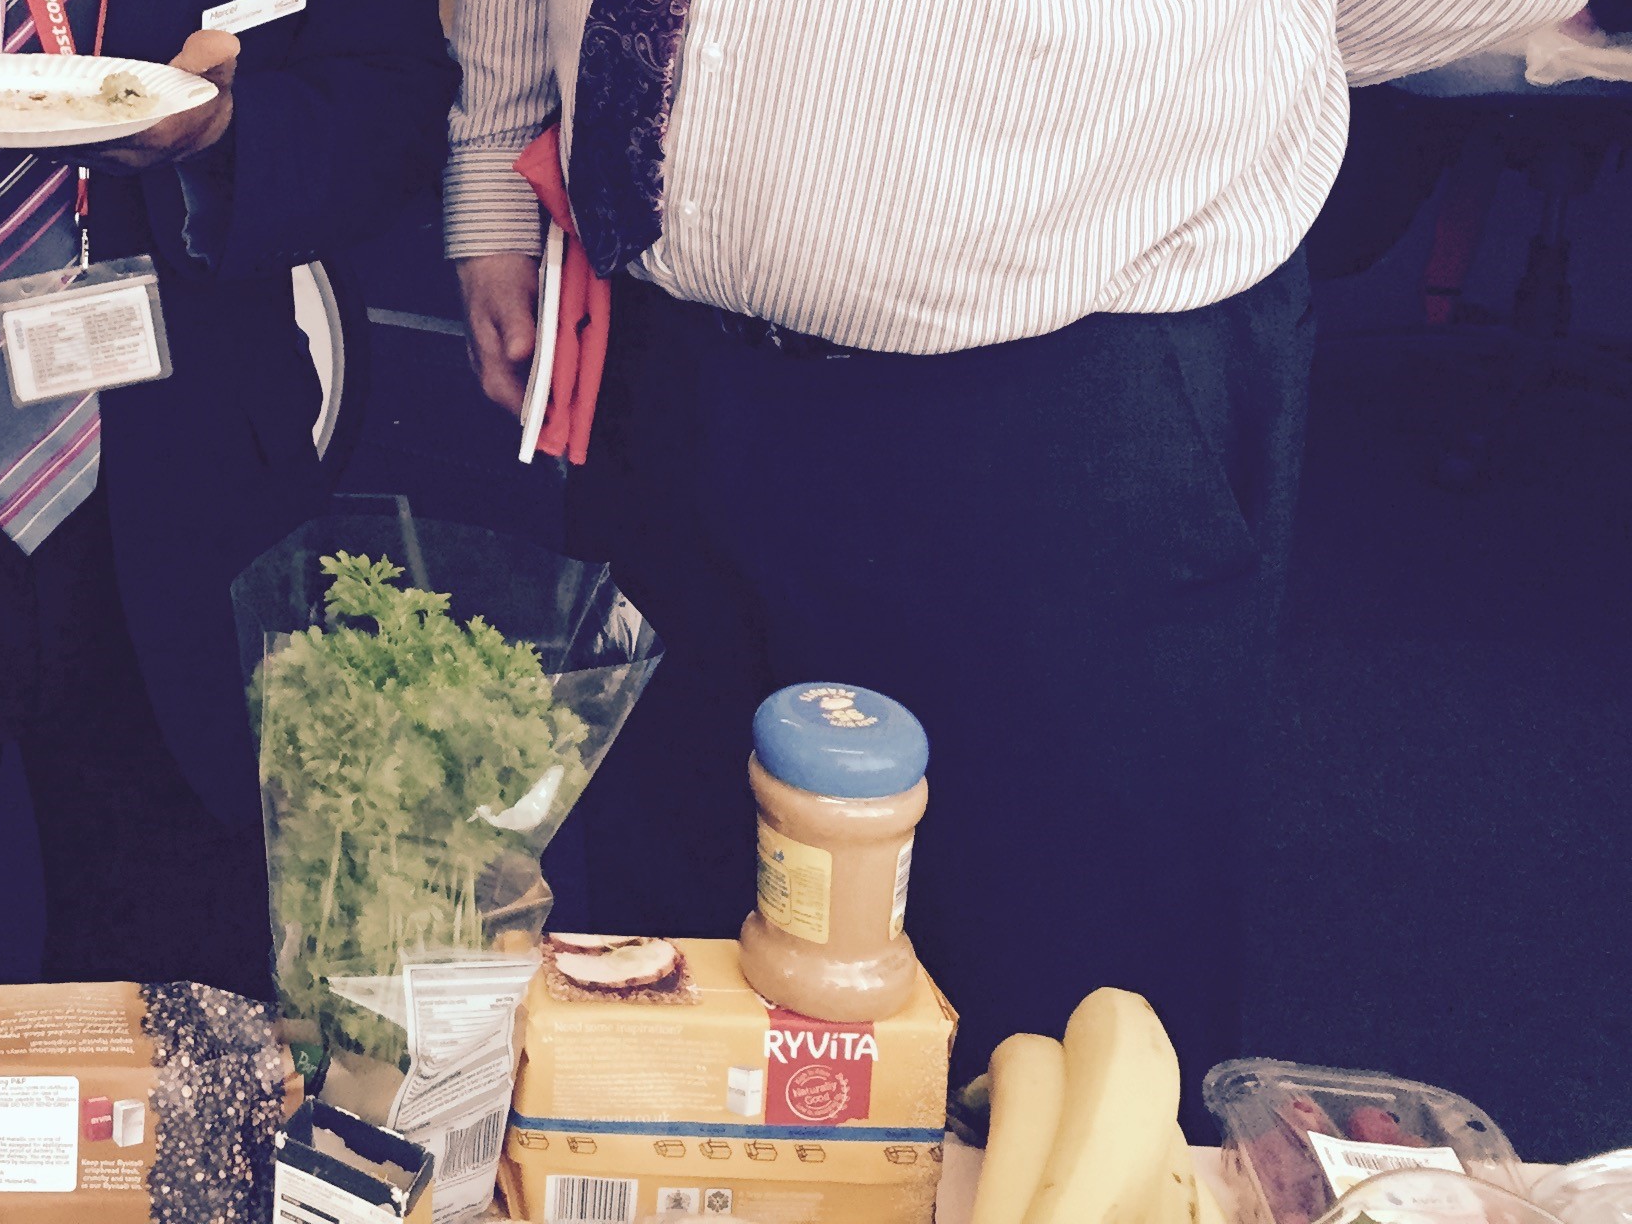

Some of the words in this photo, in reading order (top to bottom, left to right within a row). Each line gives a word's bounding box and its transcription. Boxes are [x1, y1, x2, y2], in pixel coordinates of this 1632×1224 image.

[52, 26, 74, 55] ast
[554, 1021, 583, 1033] Need
[584, 1023, 613, 1033] some
[616, 1022, 682, 1036] inspiration?
[792, 1081, 837, 1097] Naturally
[805, 1092, 830, 1104] Good
